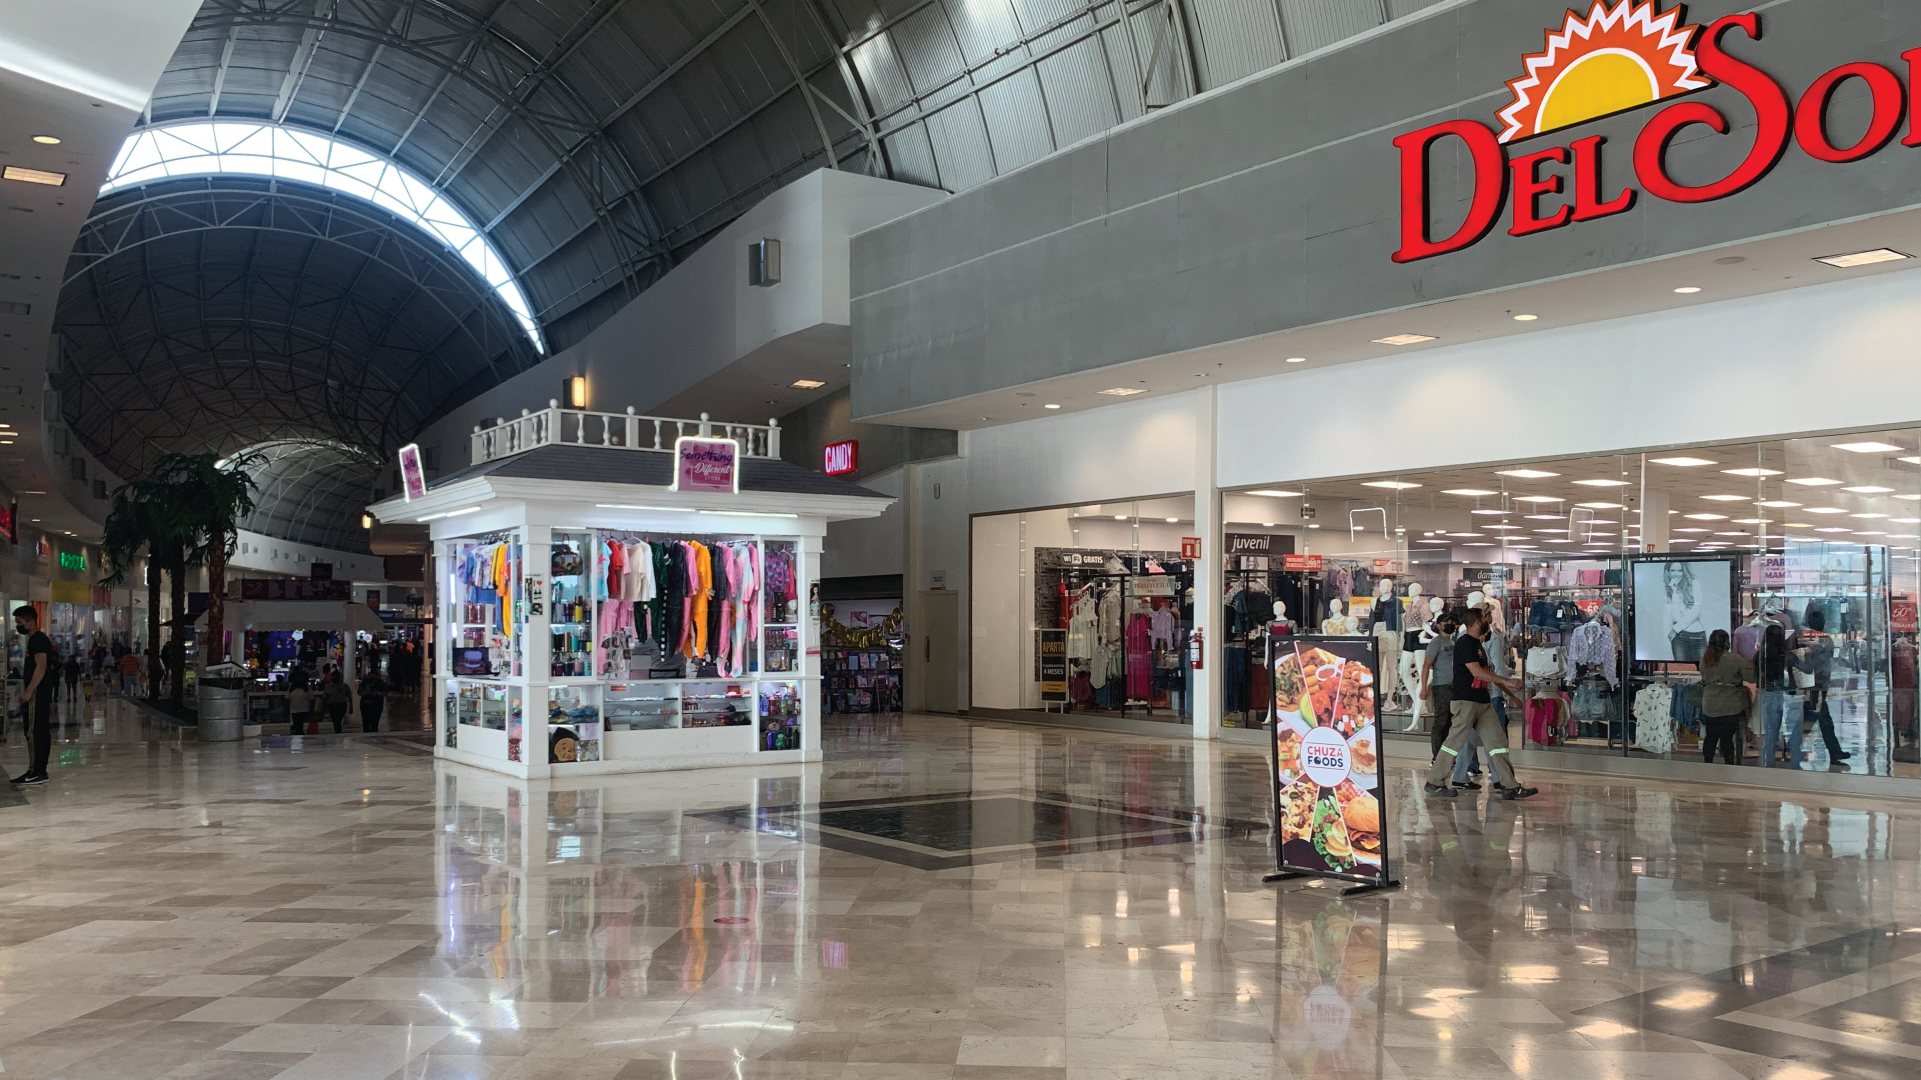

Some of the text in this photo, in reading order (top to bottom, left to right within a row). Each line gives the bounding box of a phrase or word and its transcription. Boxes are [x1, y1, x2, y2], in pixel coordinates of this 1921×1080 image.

[680, 448, 732, 467] Something
[825, 442, 852, 473] CANDY
[695, 462, 730, 476] Different
[1231, 535, 1270, 553] juvenil
[1083, 555, 1104, 564] GRATIS
[1042, 641, 1065, 653] APARTA
[1307, 745, 1344, 758] CHUZA
[1307, 755, 1344, 768] FOODS
